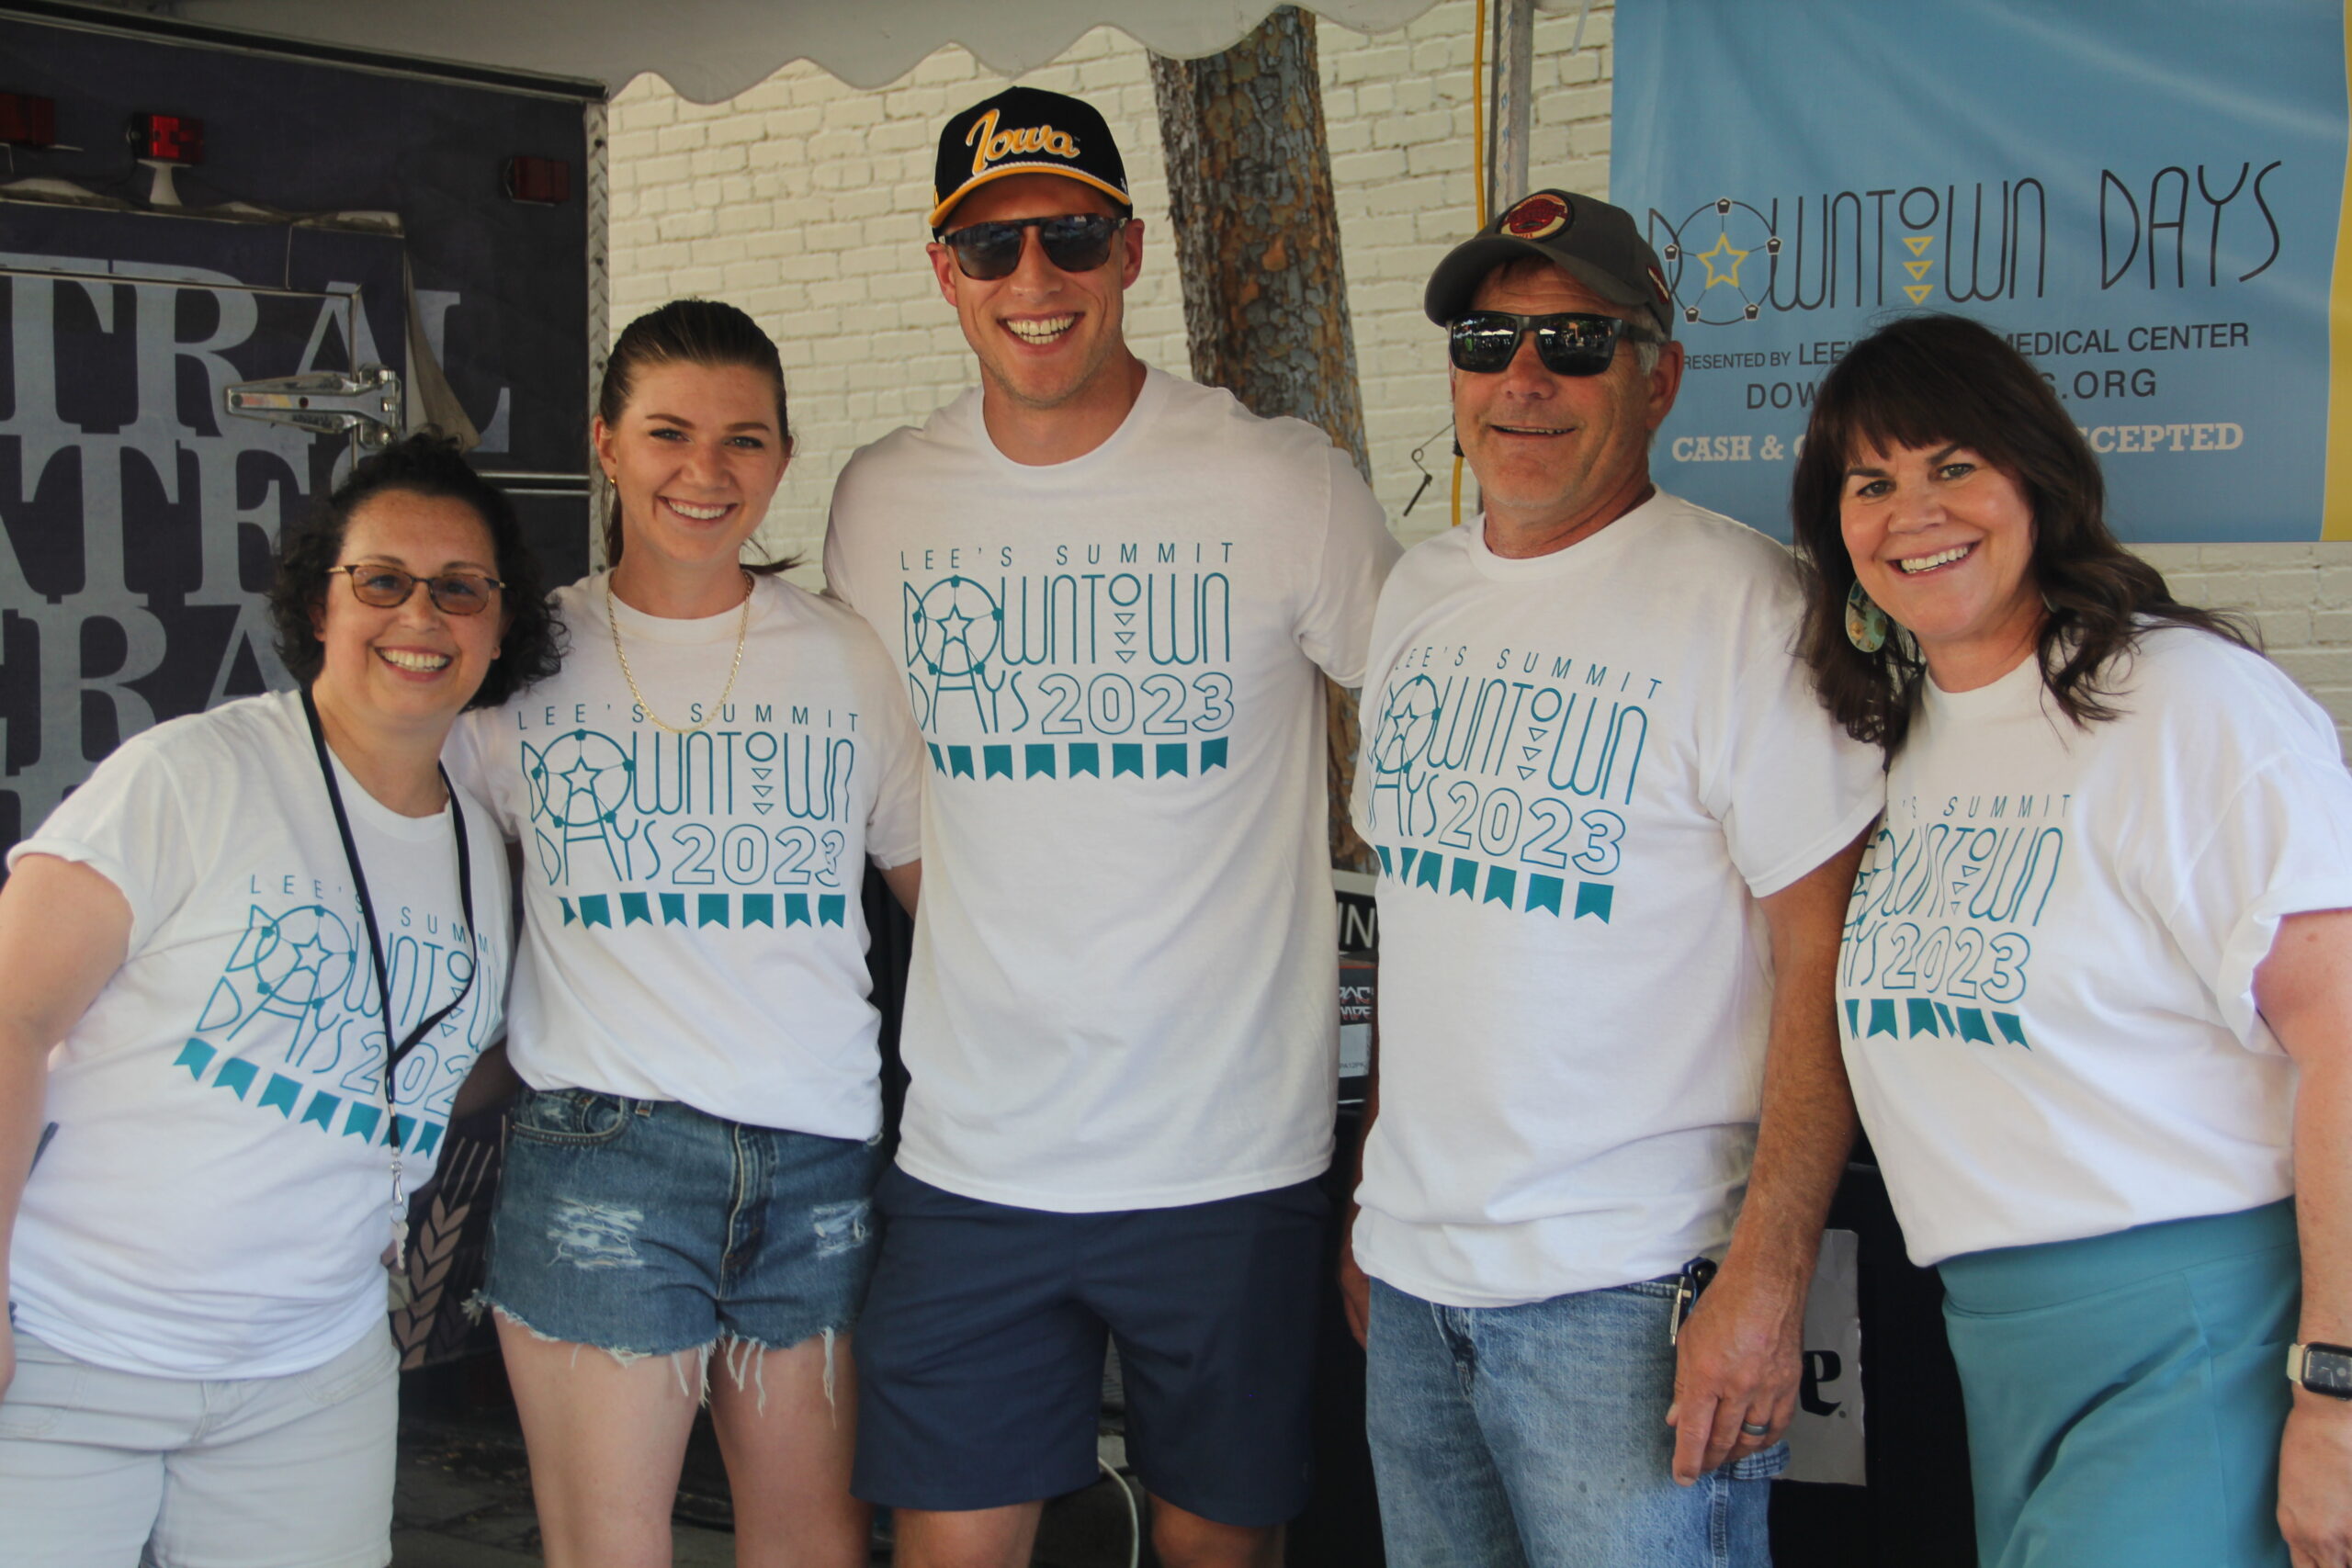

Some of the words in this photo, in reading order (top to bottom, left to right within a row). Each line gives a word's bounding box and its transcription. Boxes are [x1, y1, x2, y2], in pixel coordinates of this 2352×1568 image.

[966, 107, 1080, 176] Iowa
[2099, 160, 2282, 290] DAYS
[1684, 352, 1766, 370] RESENTED
[1770, 351, 1792, 367] BY
[1799, 341, 1852, 366] LEE'
[2128, 322, 2249, 352] CENTER
[1672, 434, 1751, 461] CASH
[1759, 434, 1783, 460] &
[899, 546, 1012, 570] LEE'S
[1057, 542, 1234, 566] SUMMIT
[903, 572, 1230, 677] DOWNTOWN
[909, 637, 1029, 734] DAYS
[1038, 671, 1235, 736] 2023
[1496, 648, 1663, 700] SUMMIT
[519, 703, 645, 730] LEE'S
[689, 702, 858, 732] SUMMIT
[521, 728, 855, 828] DOWNTOWN
[1942, 794, 2071, 818] SUMMIT
[536, 788, 662, 886] DAYS
[672, 823, 845, 887] 2023
[1438, 780, 1626, 875] 2023
[1882, 921, 2031, 1004] 2023
[195, 966, 355, 1074] DAYS
[340, 1031, 470, 1119] 202
